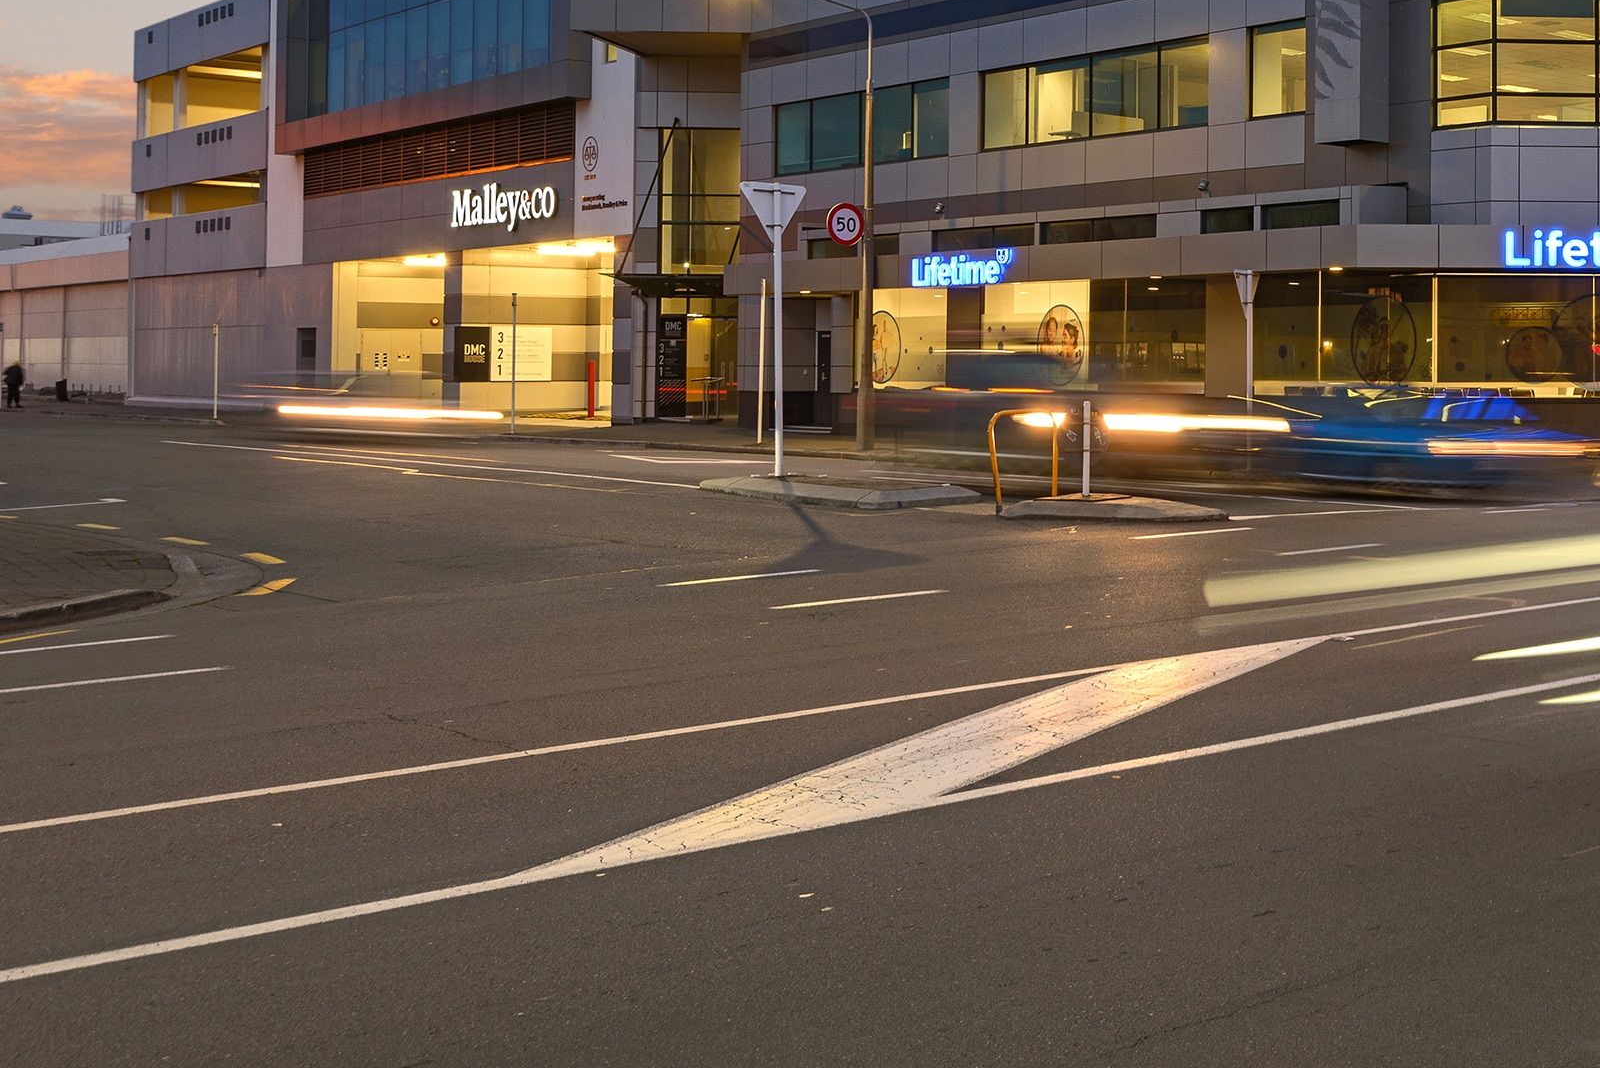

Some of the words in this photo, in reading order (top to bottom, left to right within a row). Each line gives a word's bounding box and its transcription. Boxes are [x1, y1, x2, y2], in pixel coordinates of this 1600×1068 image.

[837, 217, 856, 232] 50
[911, 254, 1001, 287] Lifetime
[664, 321, 682, 330] DMC
[497, 331, 504, 343] 3
[464, 343, 486, 355] DMC
[497, 348, 504, 359] 2
[659, 343, 664, 353] 3
[659, 355, 664, 365] 2
[497, 364, 502, 376] 1
